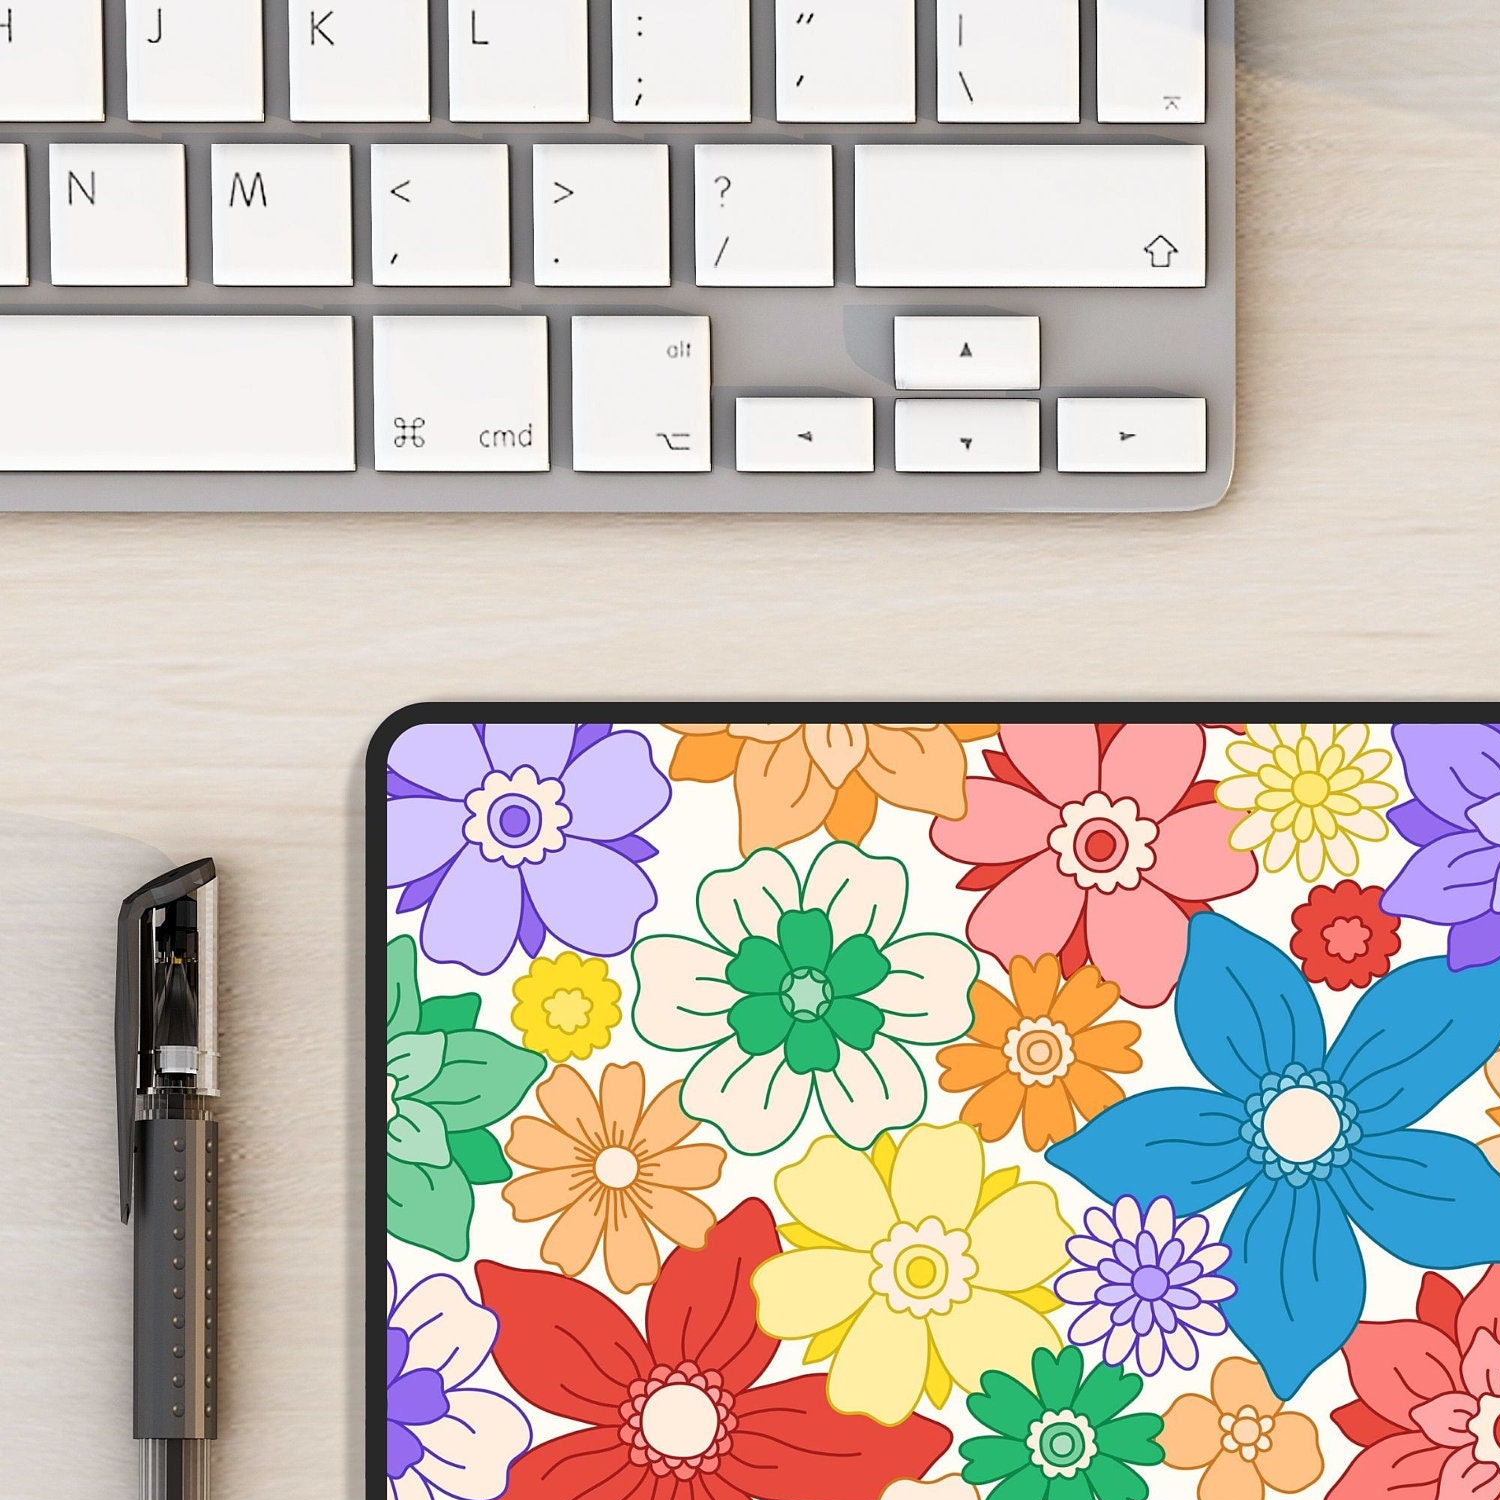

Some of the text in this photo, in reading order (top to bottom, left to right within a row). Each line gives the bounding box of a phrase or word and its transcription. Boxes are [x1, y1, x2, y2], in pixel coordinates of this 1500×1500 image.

[147, 8, 162, 44] J
[310, 10, 335, 46] K
[471, 10, 490, 46] L
[67, 171, 96, 206] N
[229, 171, 268, 208] M
[389, 179, 411, 203] <
[553, 181, 575, 204] >
[713, 176, 732, 208] ?
[666, 340, 692, 360] alt
[479, 422, 533, 449] cmd
